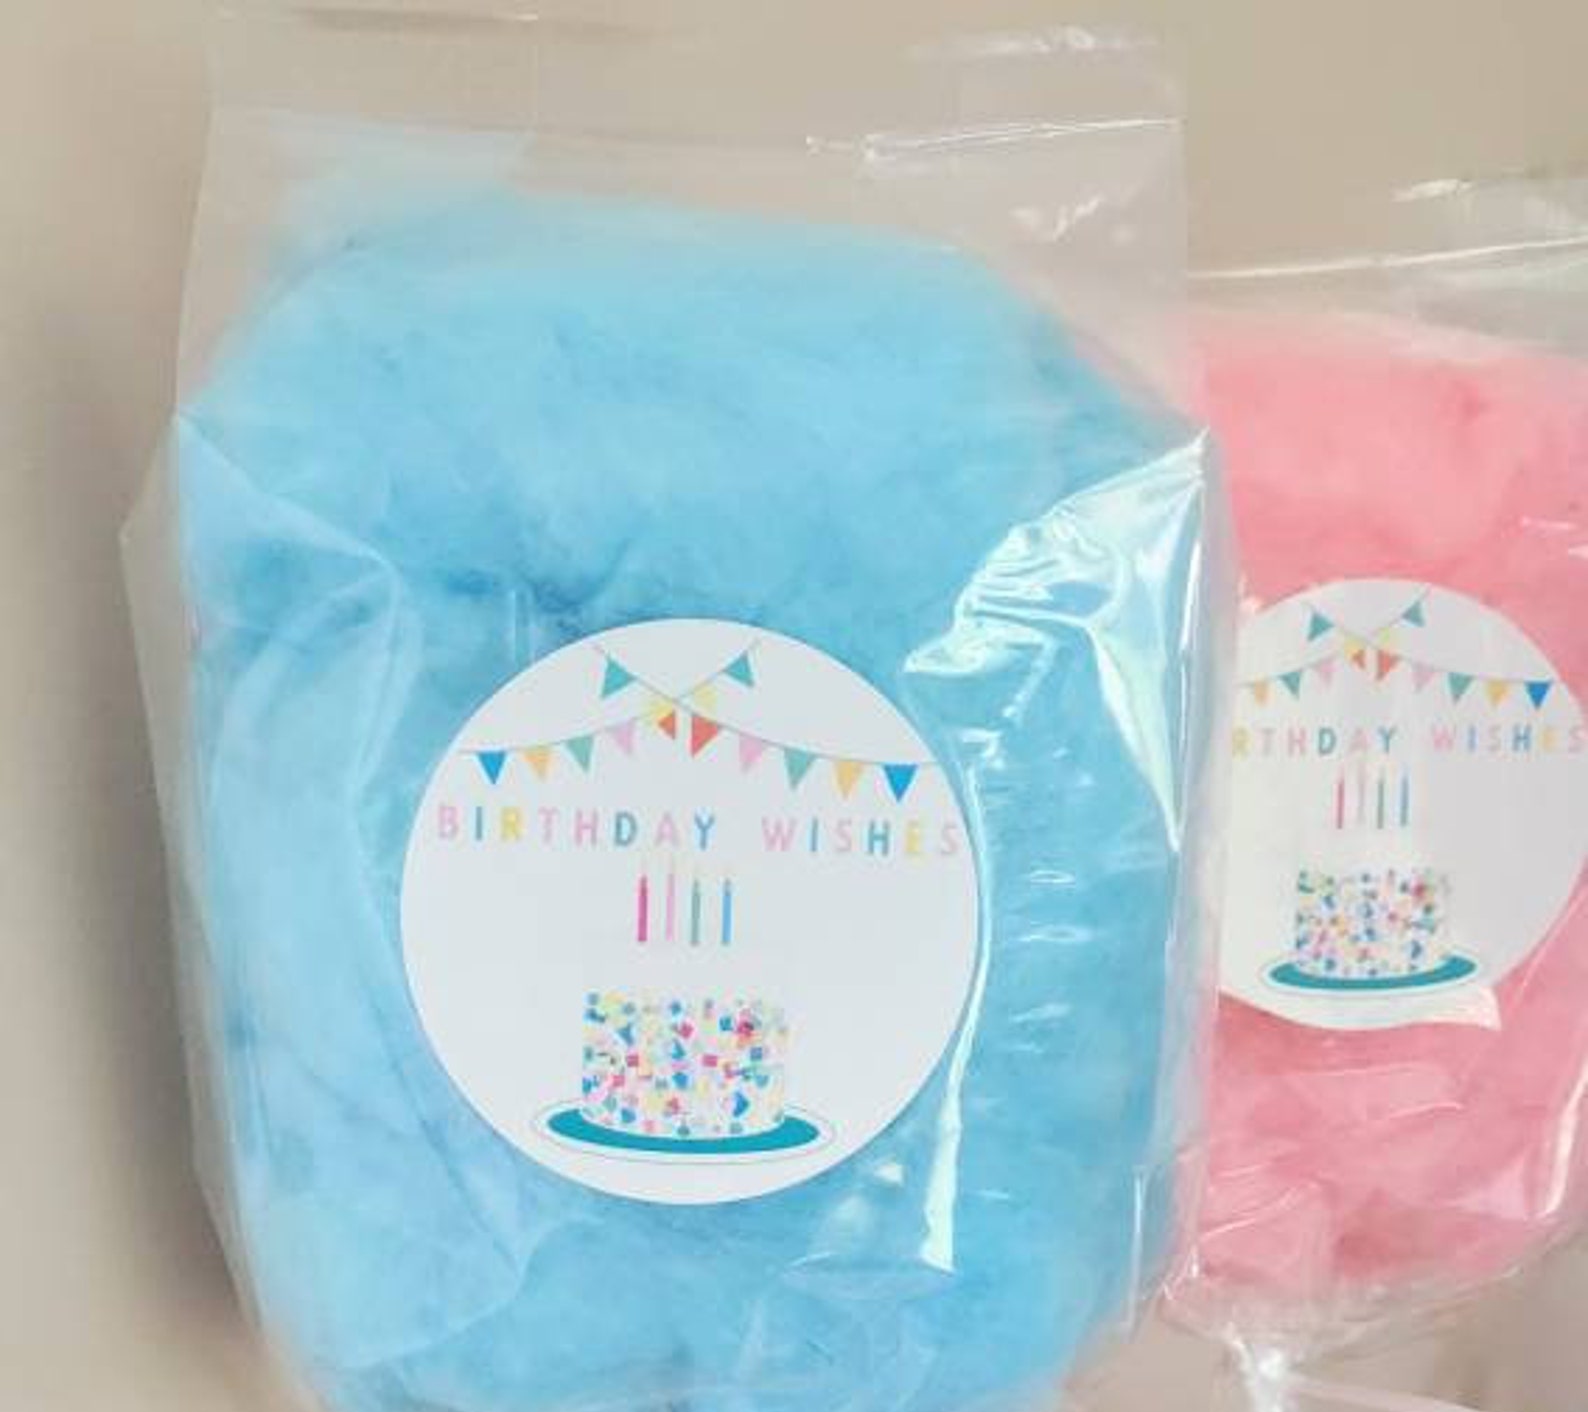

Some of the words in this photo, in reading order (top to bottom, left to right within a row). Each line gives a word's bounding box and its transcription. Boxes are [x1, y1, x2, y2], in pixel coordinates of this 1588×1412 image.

[1232, 726, 1396, 755] RTHDAY
[1431, 724, 1586, 754] WISHES
[437, 806, 716, 850] BIRTHDAY
[761, 815, 959, 857] WISHES
